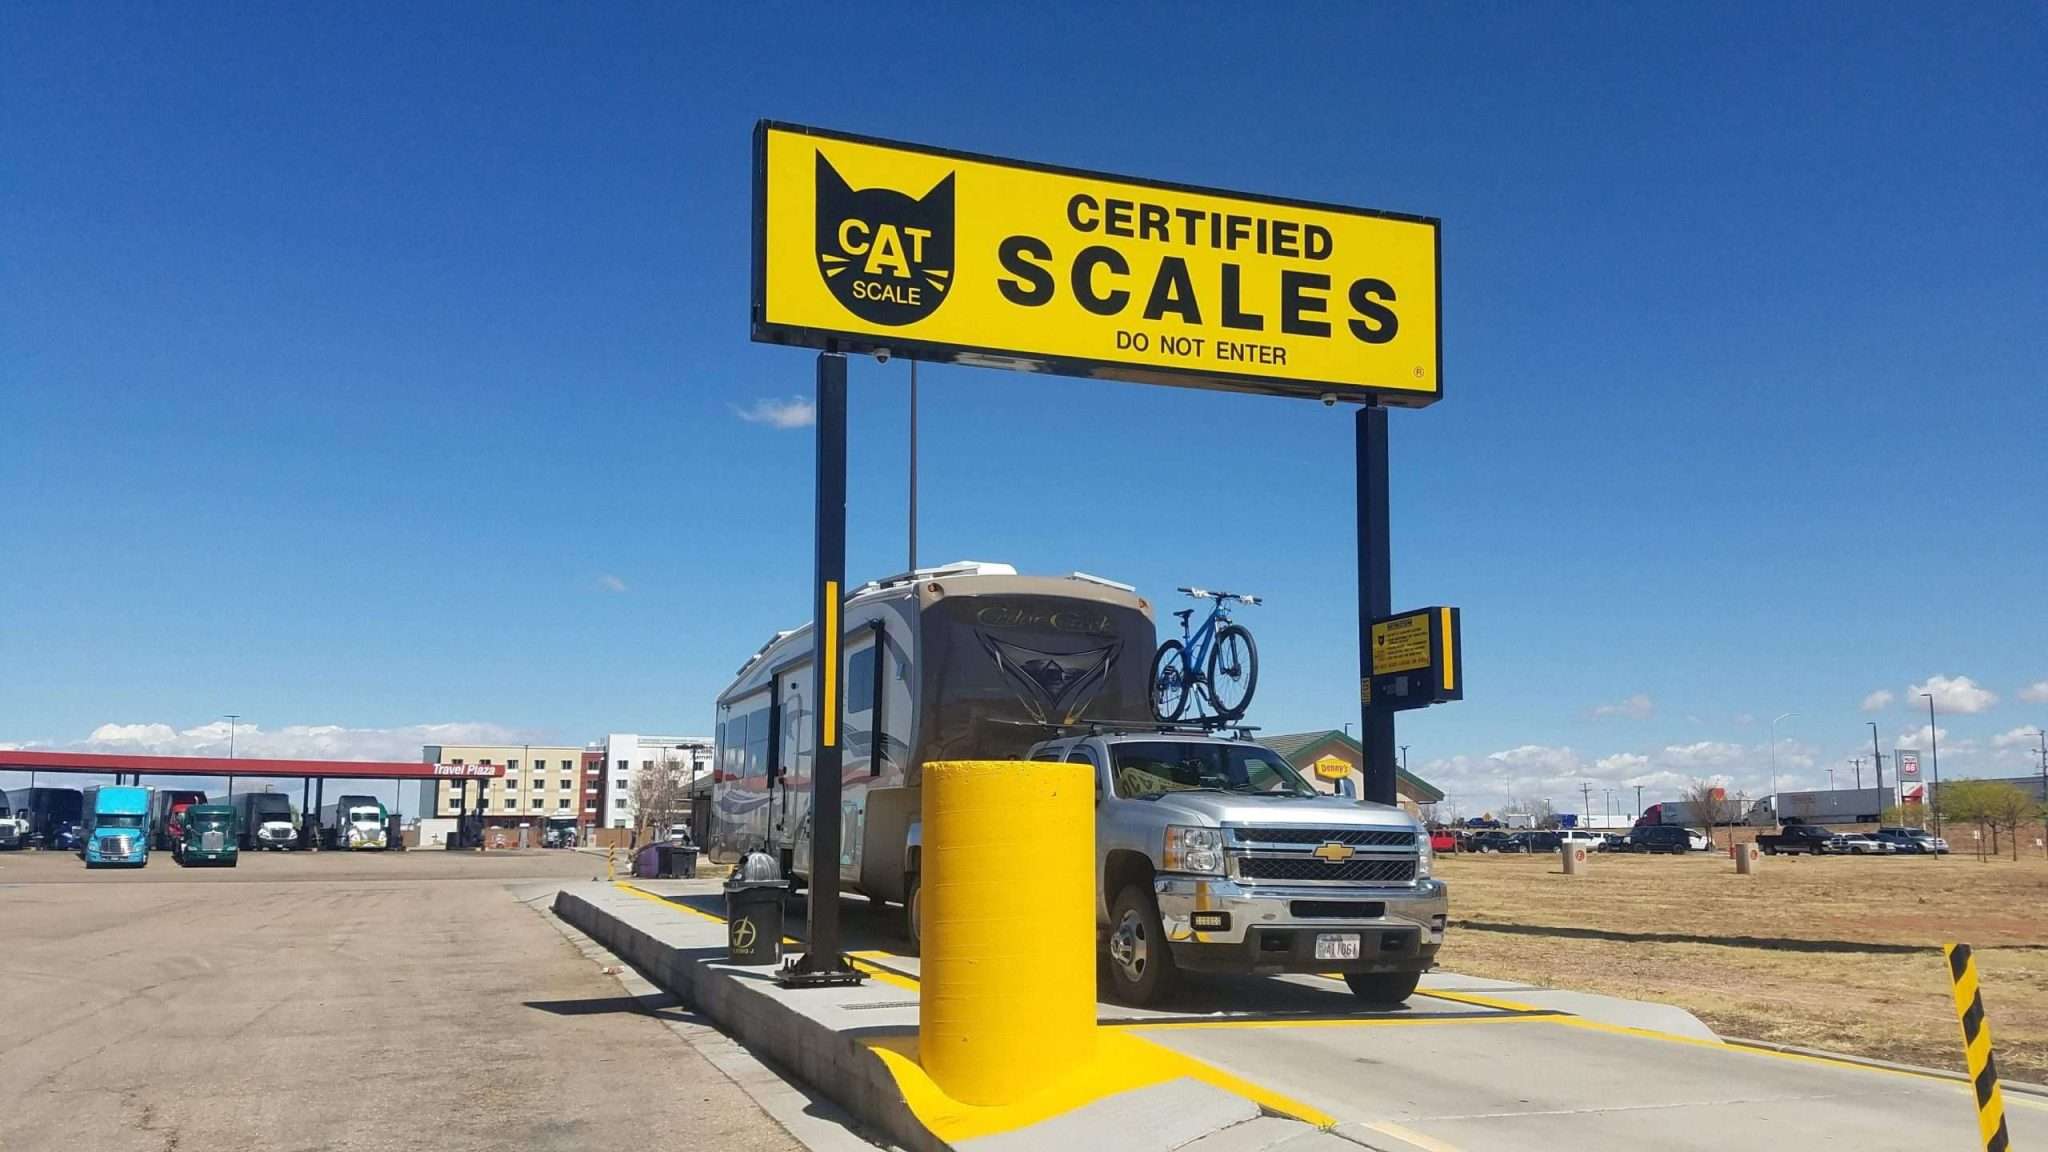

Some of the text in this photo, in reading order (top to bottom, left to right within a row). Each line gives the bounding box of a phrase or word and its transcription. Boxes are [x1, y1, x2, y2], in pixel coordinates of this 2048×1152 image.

[838, 218, 932, 278] CAT
[1067, 193, 1333, 261] CERTIFIED
[852, 280, 921, 306] SCALE
[997, 235, 1399, 345] SCALES
[1116, 330, 1287, 366] DO NOT ENTER
[432, 763, 496, 776] Travel Plaza
